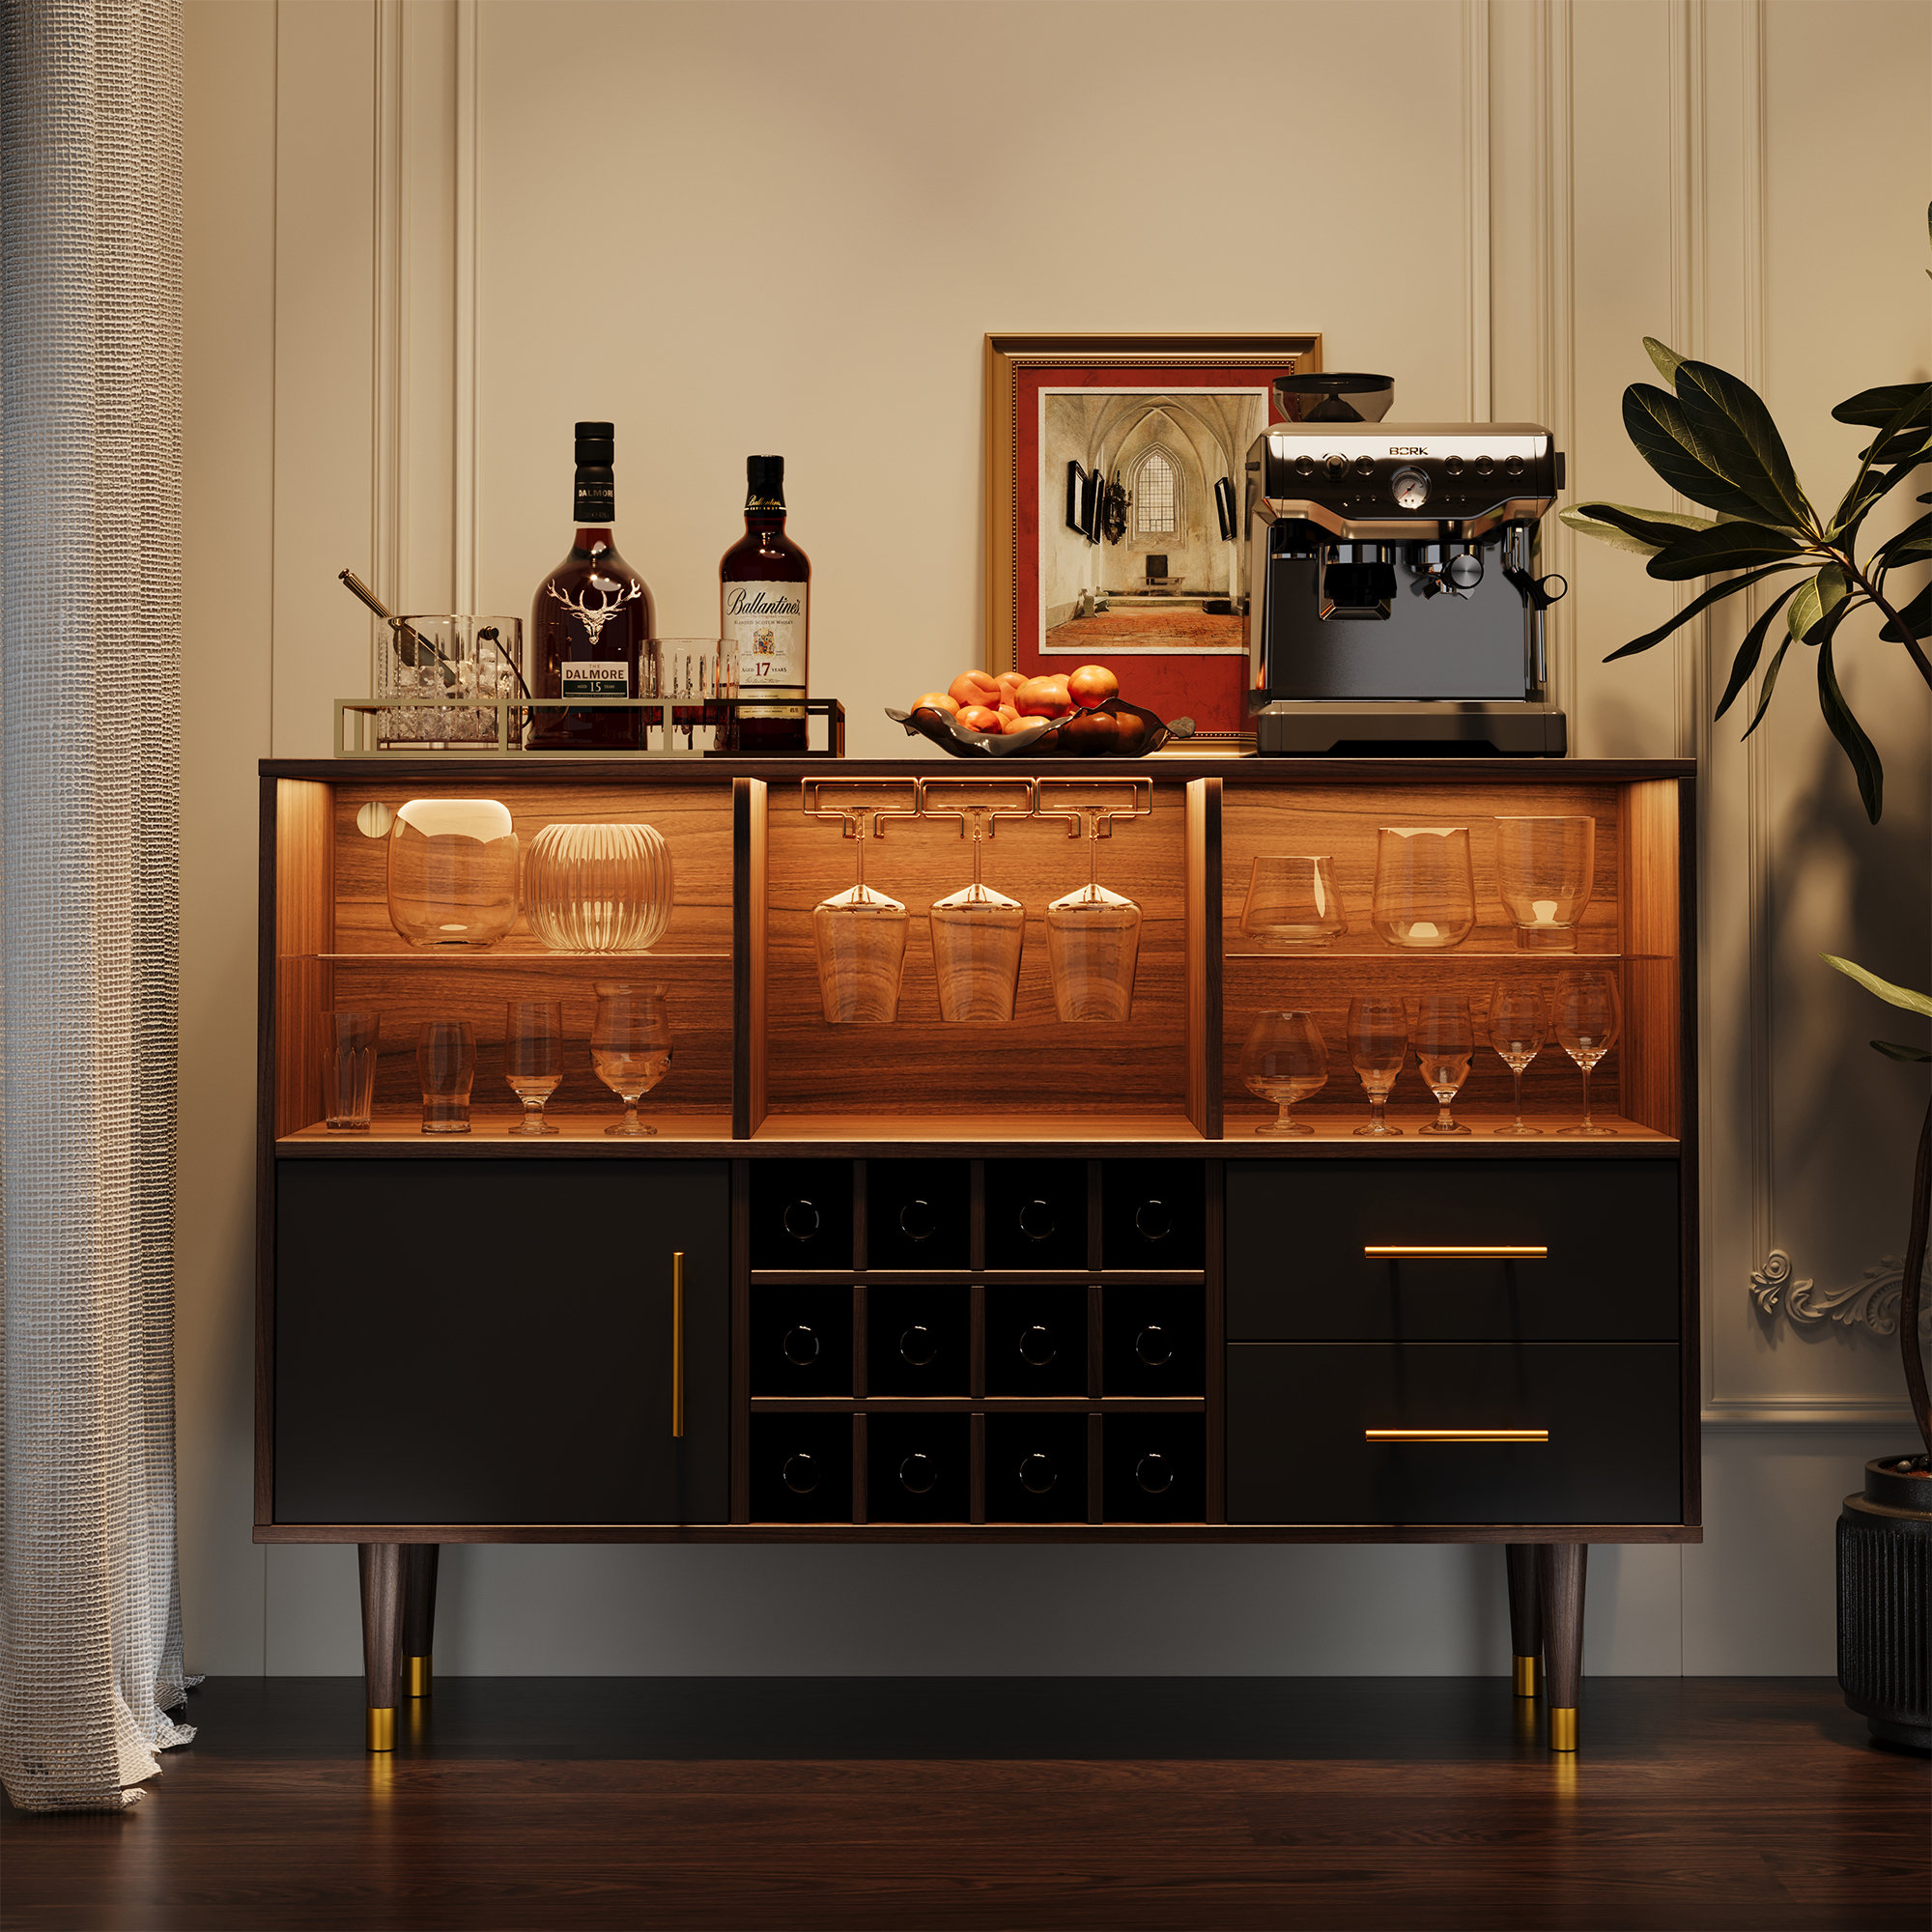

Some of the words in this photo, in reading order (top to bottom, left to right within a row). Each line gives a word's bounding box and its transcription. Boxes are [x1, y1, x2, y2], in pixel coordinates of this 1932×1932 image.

[726, 587, 801, 615] Ballantine's
[566, 669, 624, 679] DALMORE
[755, 662, 771, 676] 17
[590, 681, 601, 692] 15
